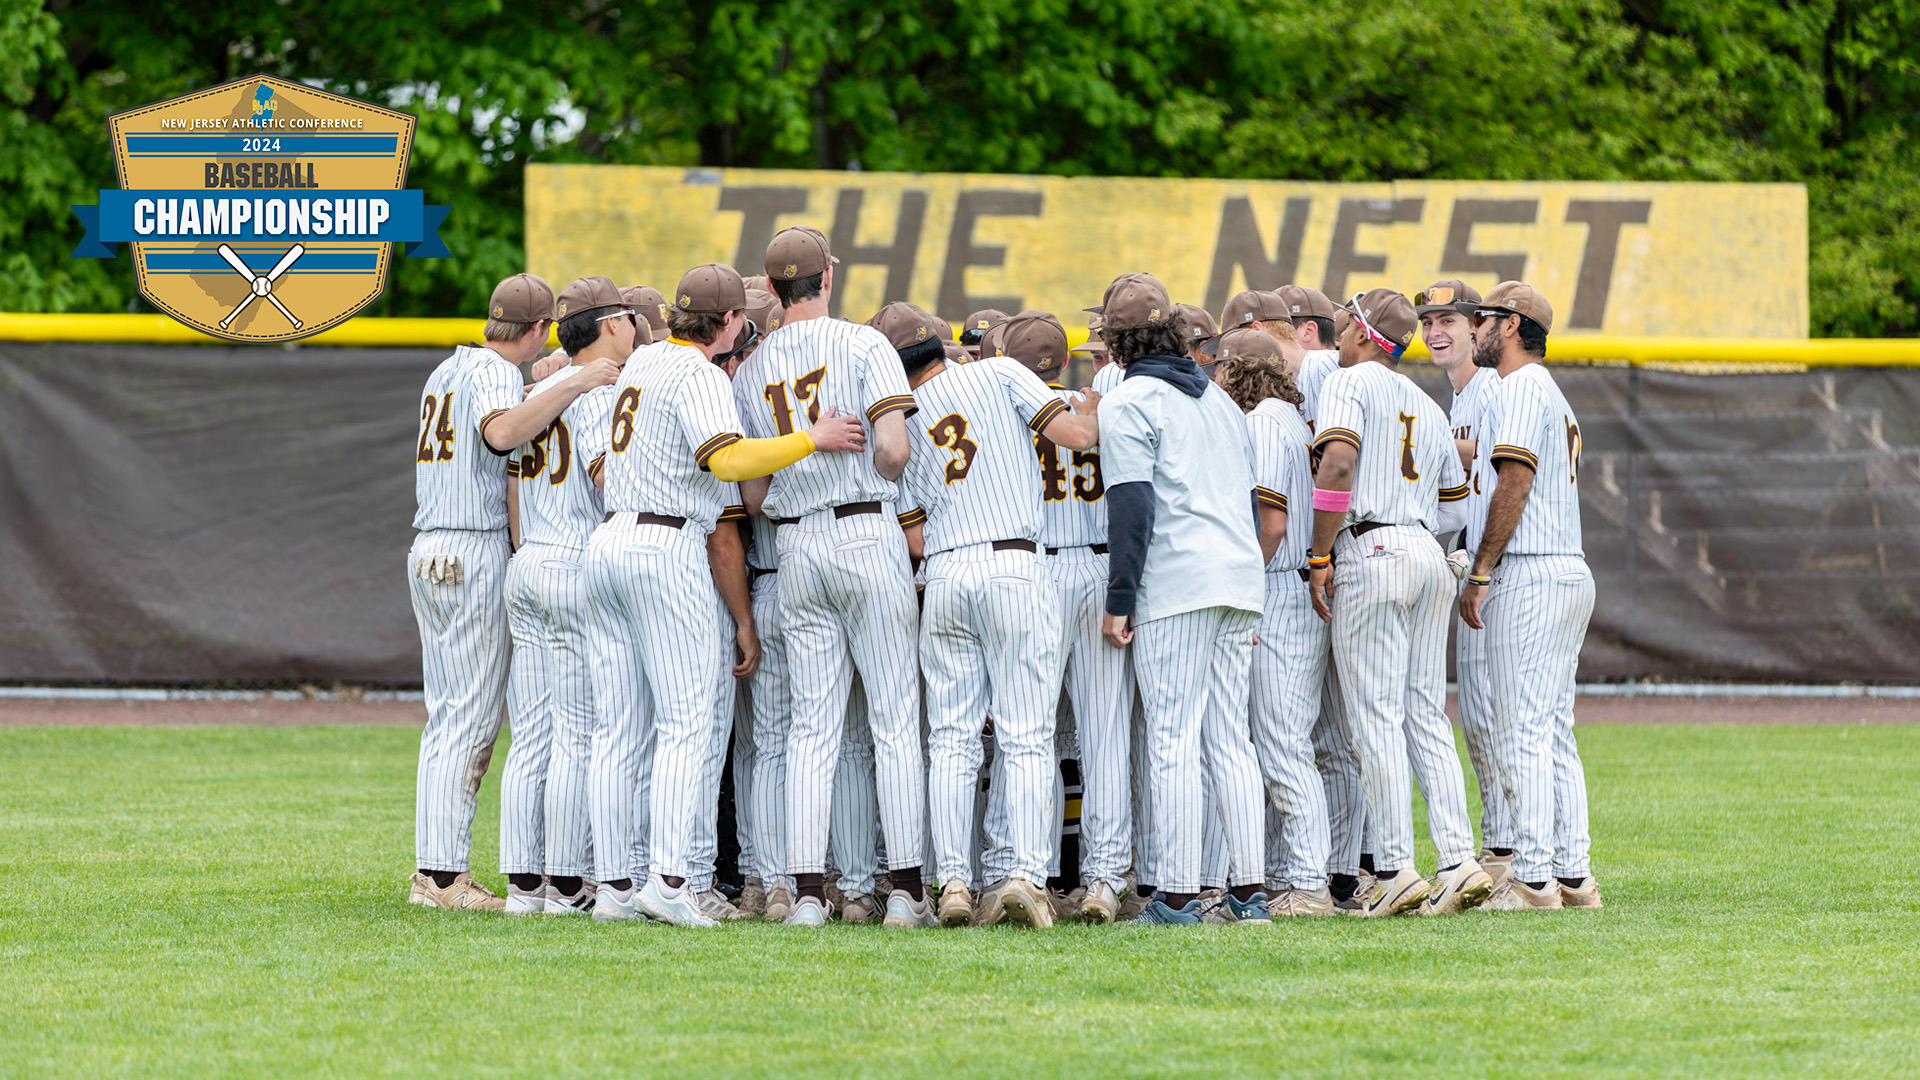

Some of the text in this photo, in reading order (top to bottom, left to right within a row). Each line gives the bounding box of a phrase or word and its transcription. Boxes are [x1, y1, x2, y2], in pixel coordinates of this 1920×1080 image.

[718, 187, 1653, 329] THE NEST
[417, 391, 454, 463] 24
[611, 385, 641, 453] 6
[764, 364, 826, 437] 17
[928, 413, 978, 486] 3
[1032, 433, 1105, 504] 45
[1398, 410, 1420, 482] 1
